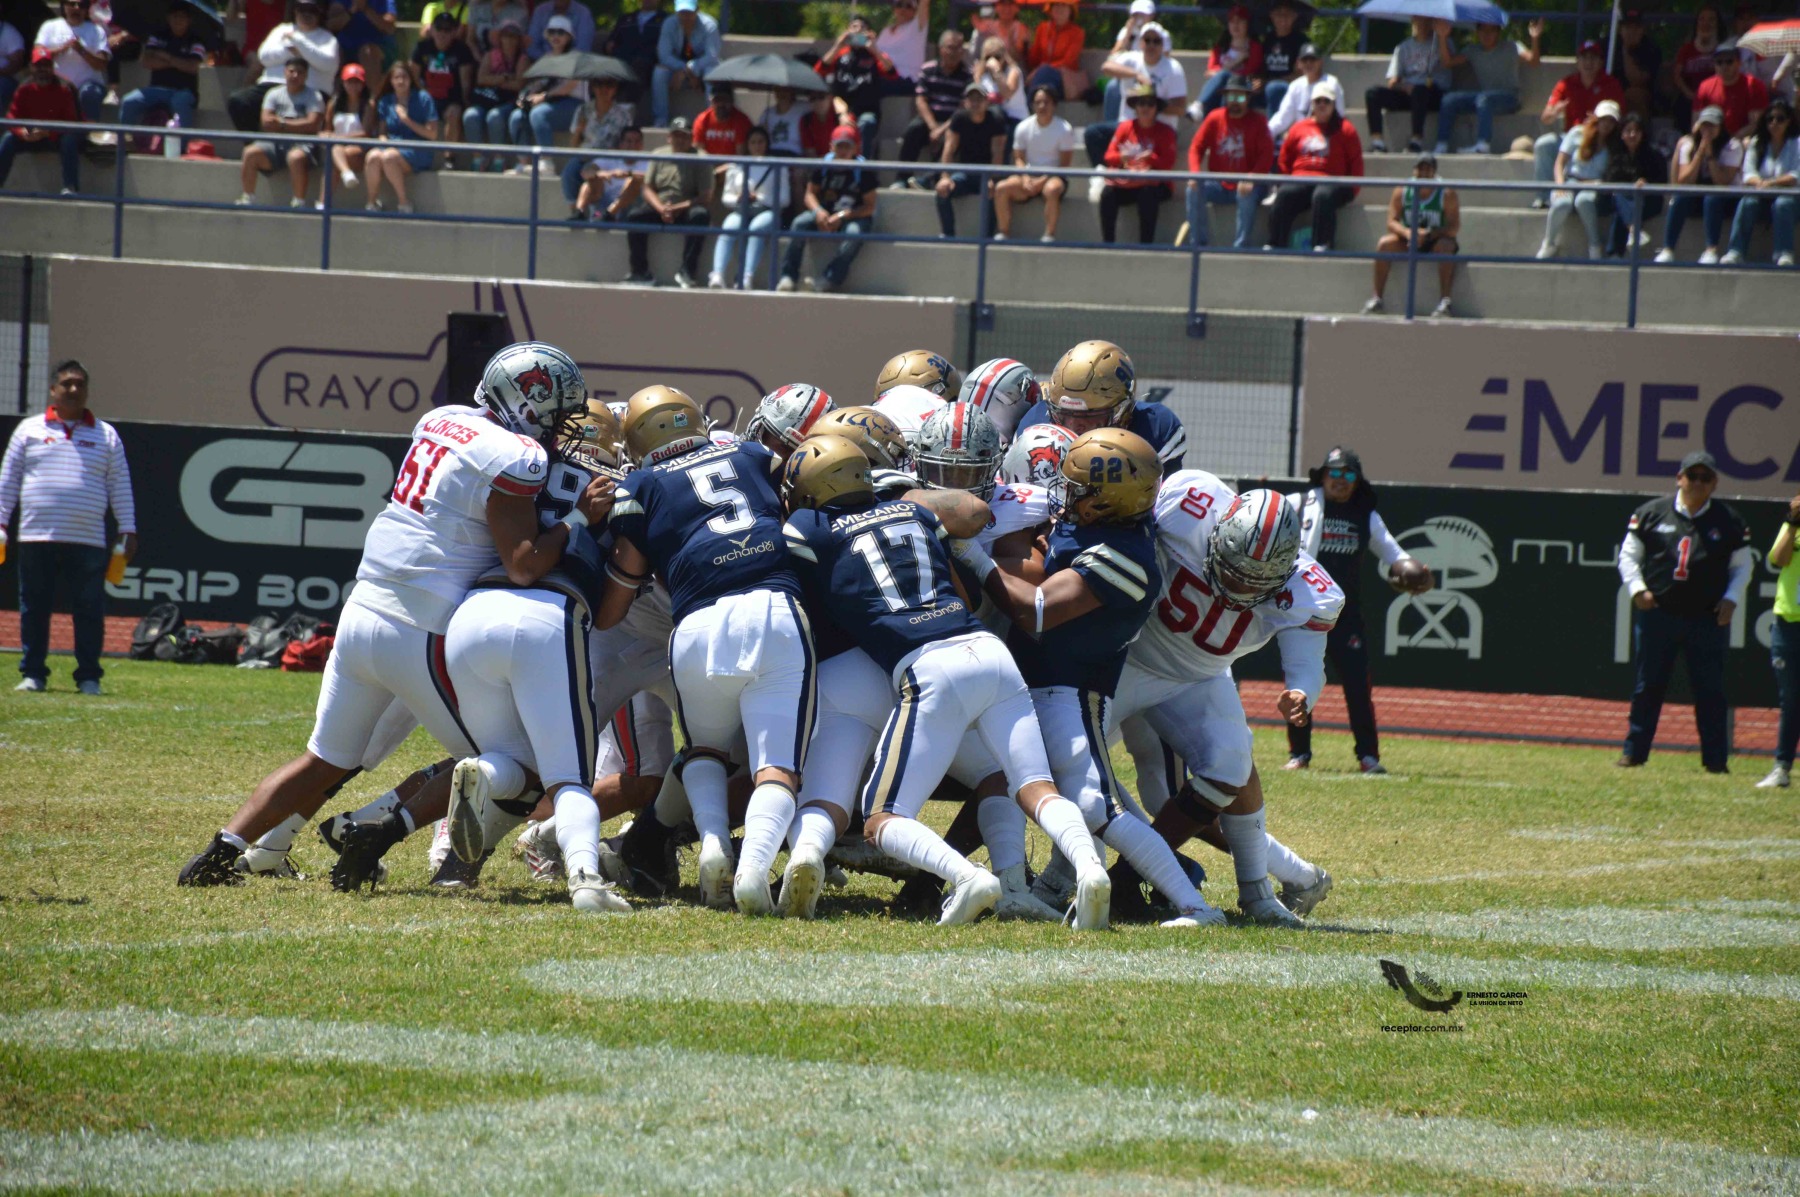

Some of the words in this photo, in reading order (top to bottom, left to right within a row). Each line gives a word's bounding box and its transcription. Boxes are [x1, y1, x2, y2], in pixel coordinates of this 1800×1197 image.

[284, 371, 421, 413] RAYO
[422, 418, 481, 445] LINCES
[650, 438, 694, 463] Riddell
[1520, 379, 1800, 482] MEC
[392, 437, 451, 516] 61
[1089, 456, 1122, 483] 22
[179, 438, 395, 550] GB
[685, 458, 757, 534] 5
[836, 503, 910, 528] MECANO
[1180, 486, 1215, 520] 50
[851, 520, 938, 613] 17
[1301, 565, 1333, 593] 50
[1673, 535, 1692, 581] 1
[104, 567, 240, 603] GRIP
[257, 574, 358, 610] BO
[1157, 565, 1254, 657] 50
